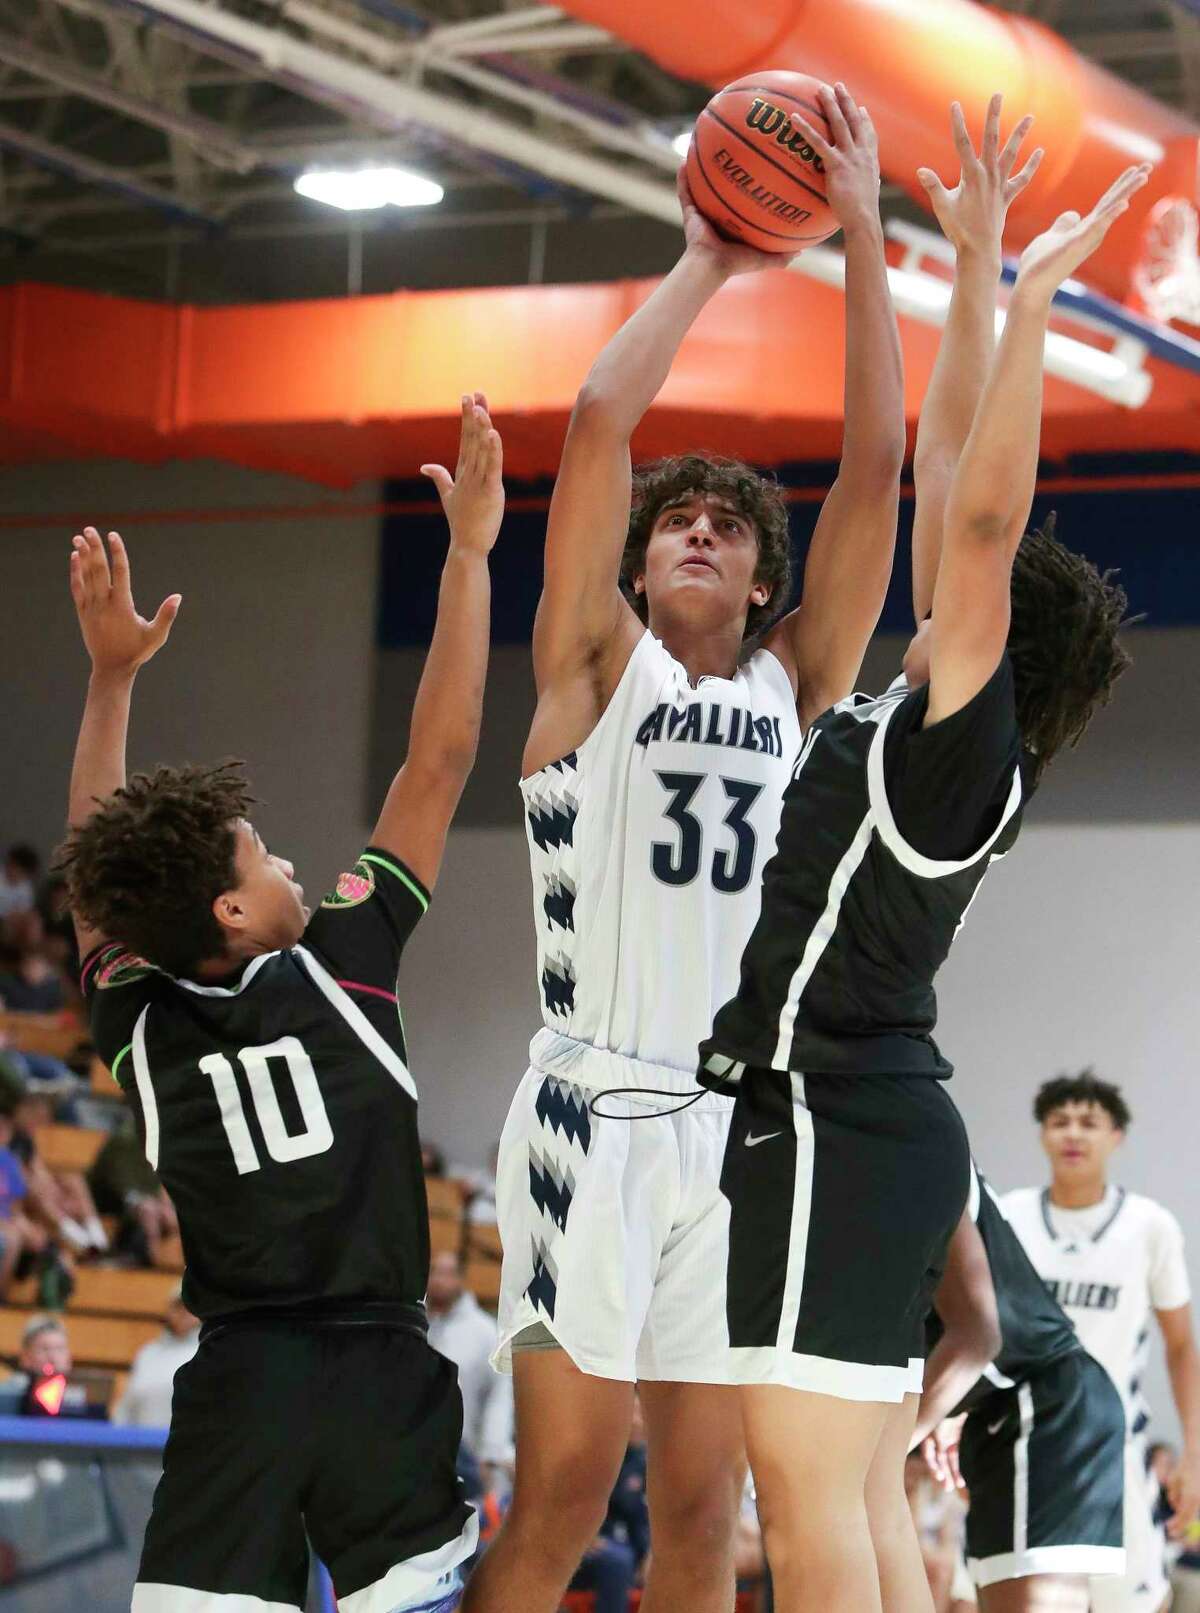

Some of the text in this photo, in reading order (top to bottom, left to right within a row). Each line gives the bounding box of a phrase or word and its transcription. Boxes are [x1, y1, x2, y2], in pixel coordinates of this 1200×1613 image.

[712, 149, 812, 224] EVOLUTION
[746, 98, 826, 174] Wils
[651, 769, 766, 896] 33
[198, 1036, 334, 1175] 10
